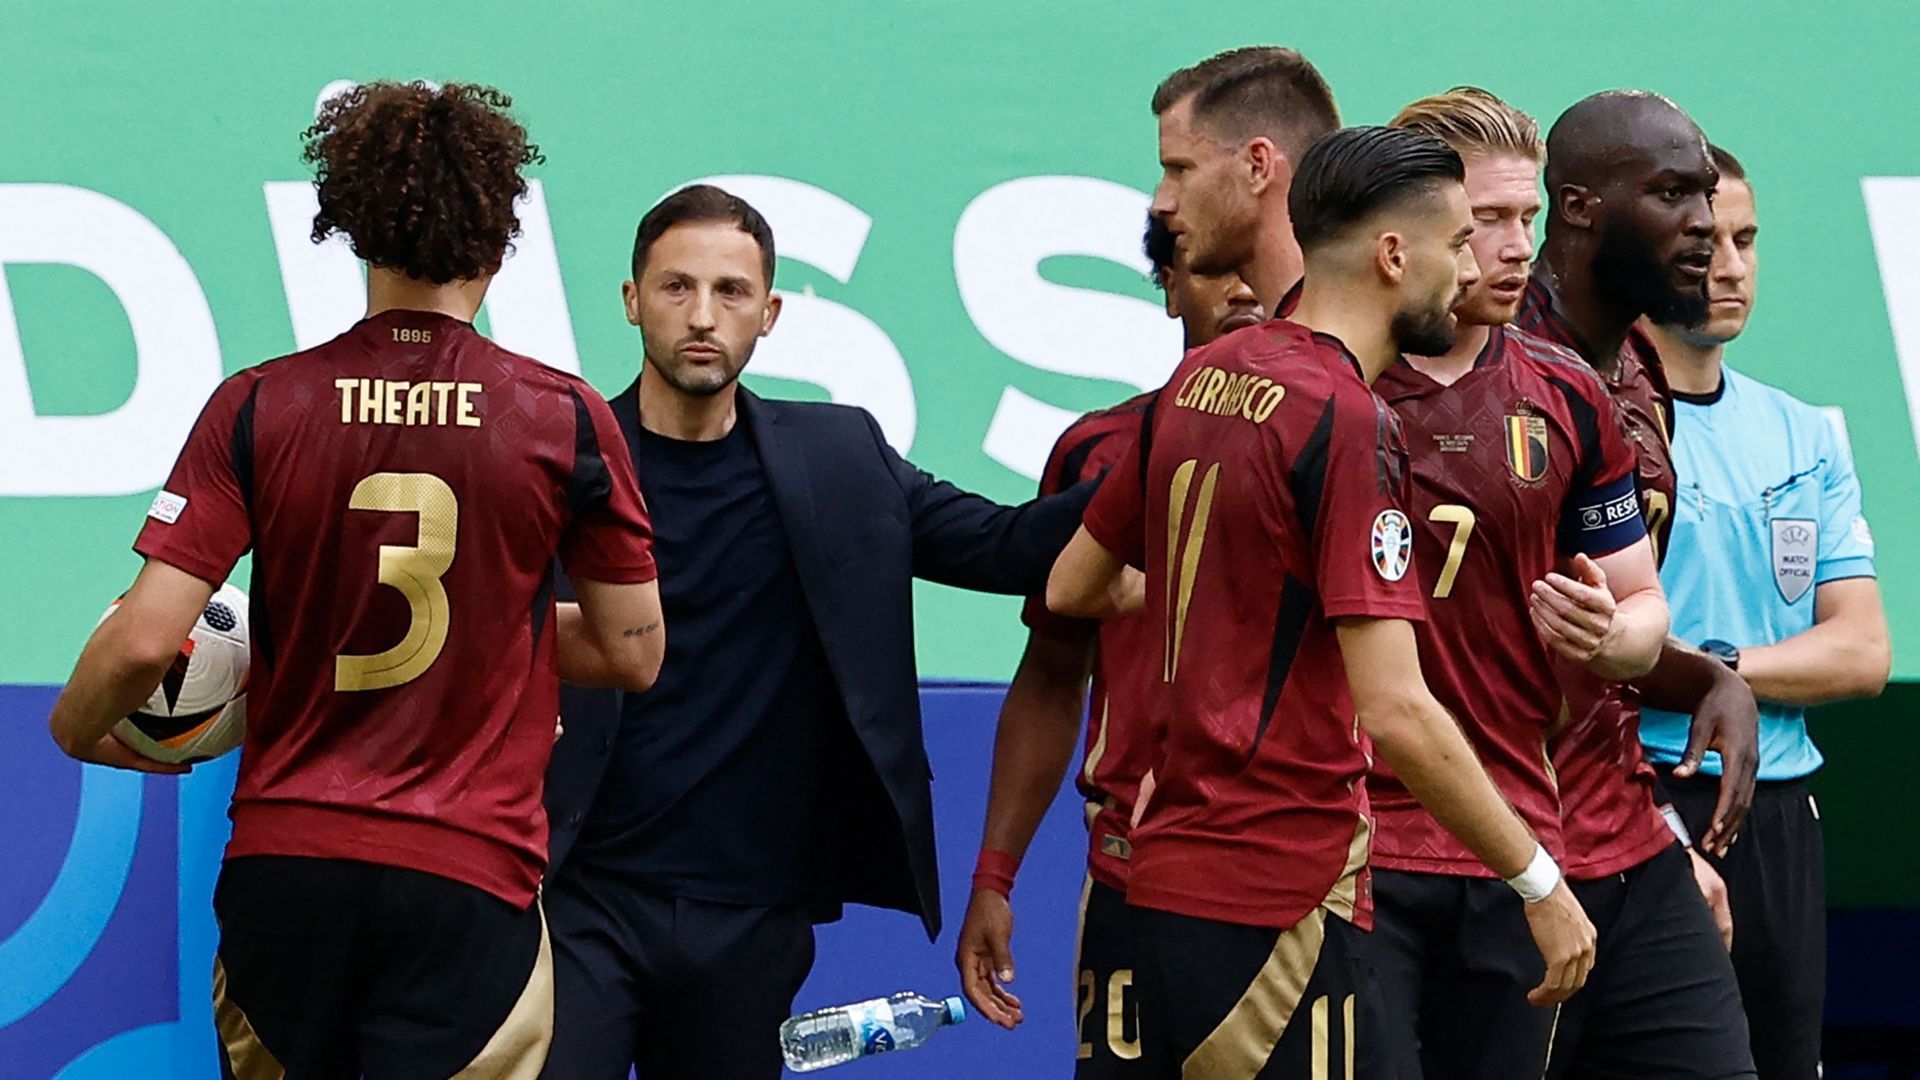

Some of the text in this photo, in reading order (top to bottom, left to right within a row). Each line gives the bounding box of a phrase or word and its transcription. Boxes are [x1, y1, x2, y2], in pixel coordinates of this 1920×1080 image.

[392, 328, 432, 343] 1895
[335, 378, 483, 427] THEATE
[1175, 366, 1286, 424] CARRASCO
[335, 472, 459, 692] 3
[1163, 459, 1221, 683] 11
[1428, 504, 1476, 598] 7
